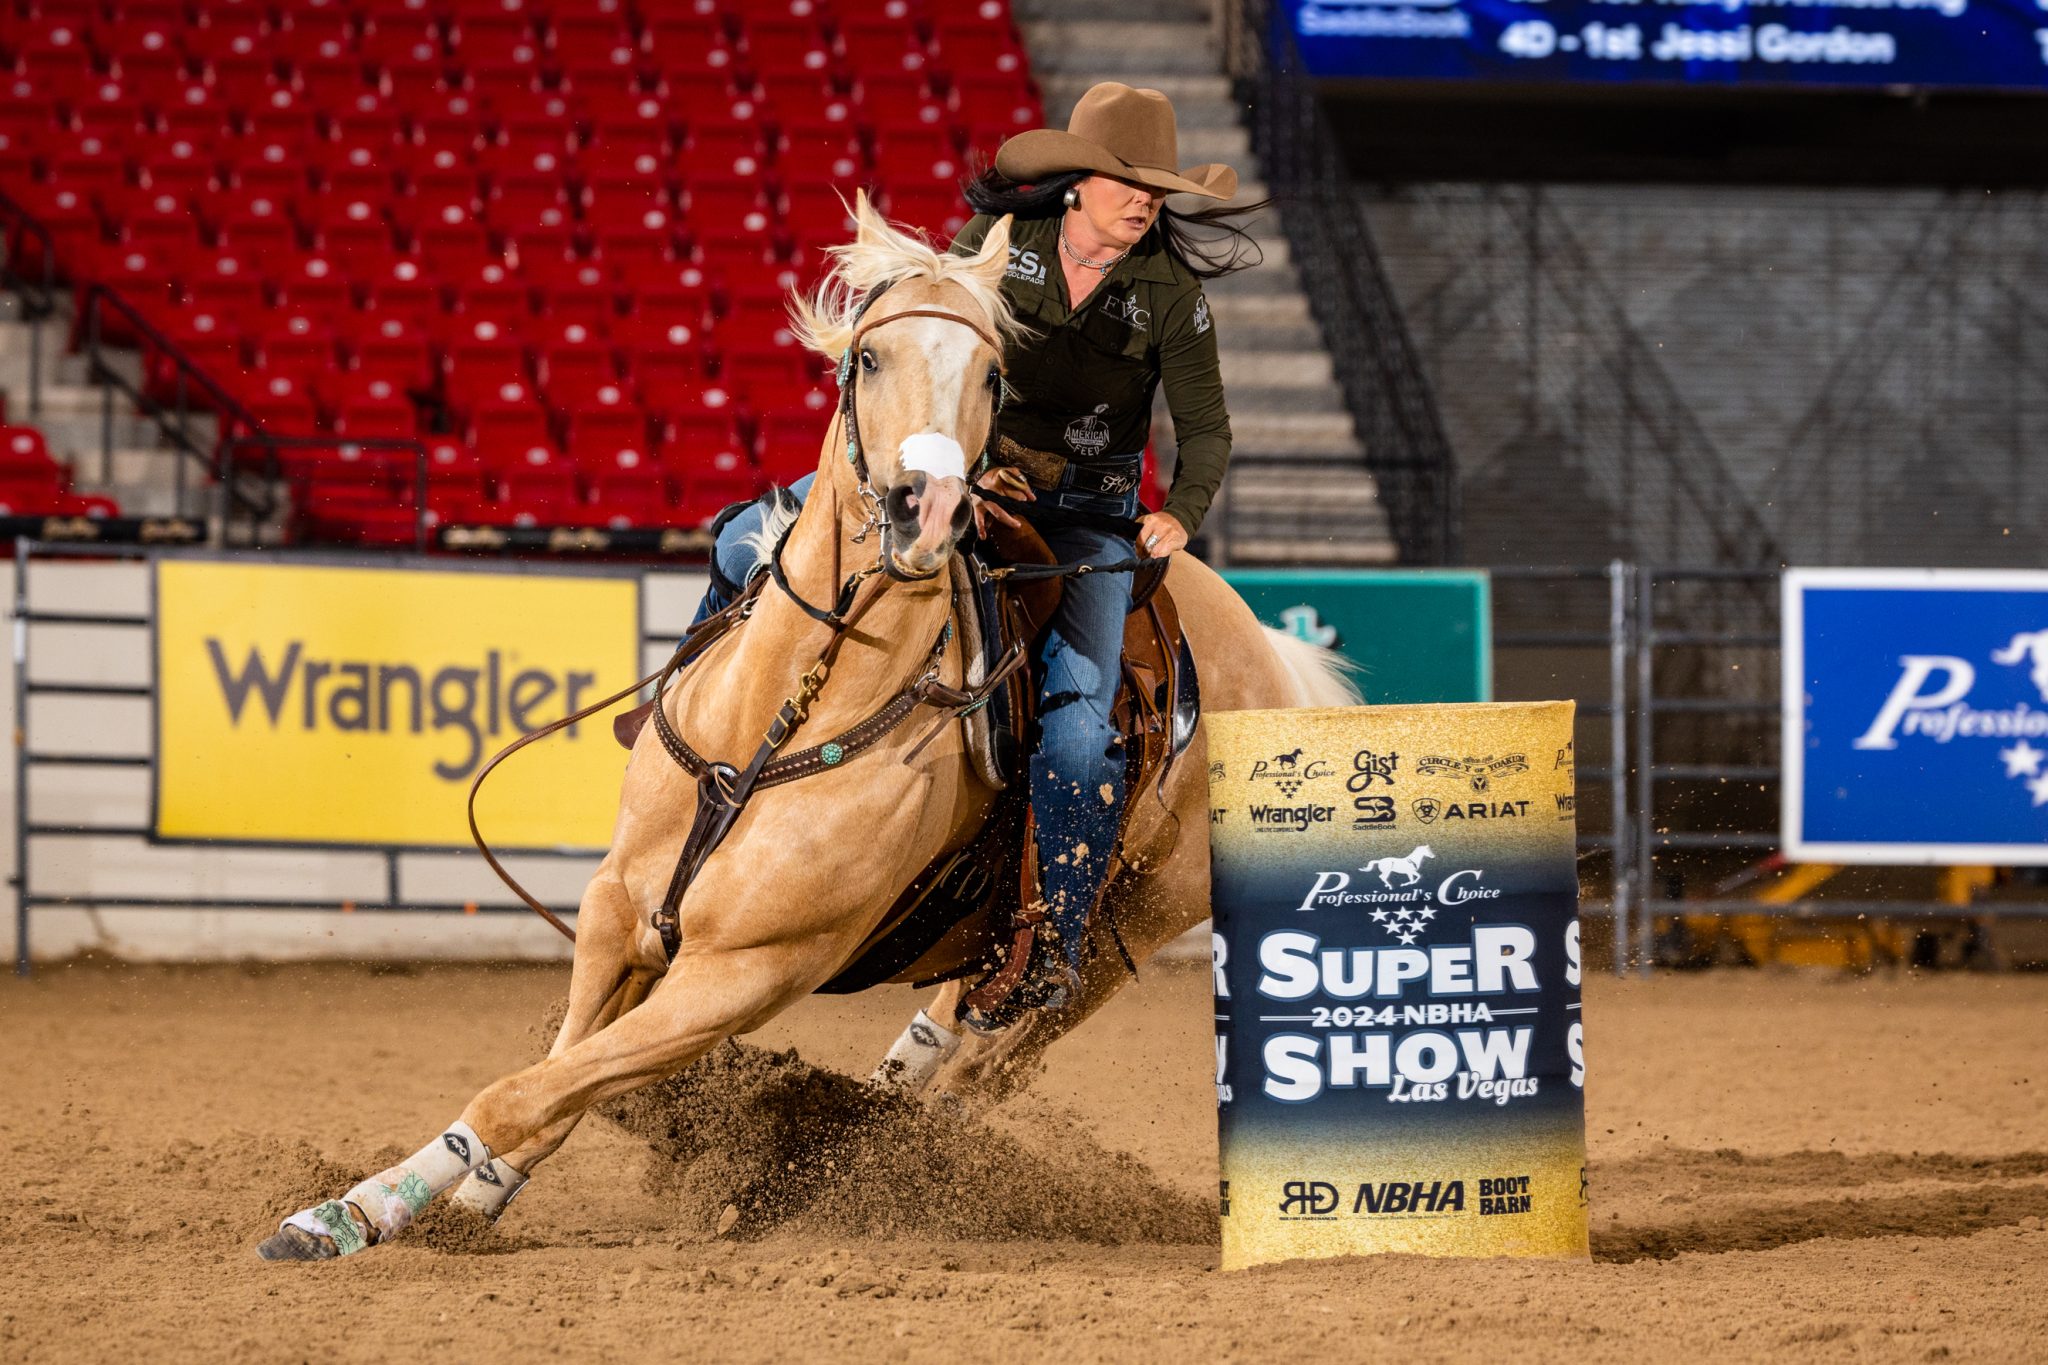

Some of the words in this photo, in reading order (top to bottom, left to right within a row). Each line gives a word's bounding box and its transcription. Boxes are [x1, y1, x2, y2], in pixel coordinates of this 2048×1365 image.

[1582, 21, 1643, 60] 1st
[1651, 22, 1752, 61] Jessi
[1755, 23, 1896, 63] Gordon
[1063, 425, 1110, 443] AMERICAN
[1073, 444, 1101, 456] FEED
[204, 636, 596, 782] Wrangler
[1853, 654, 2048, 750] Professio
[1249, 761, 1300, 782] Professional's
[1304, 761, 1336, 780] Choice
[1346, 750, 1400, 793] Gist
[1419, 757, 1461, 770] CIRCLE
[1464, 765, 1472, 773] Y
[1488, 755, 1526, 771] YOAKUM
[1250, 804, 1336, 832] Wrangler
[1444, 801, 1529, 819] ARIAT
[1352, 823, 1397, 831] SaddleBook
[1296, 871, 1432, 911] Professional's
[1437, 869, 1501, 906] Choice
[1257, 925, 1540, 999] SUPER
[1311, 1005, 1398, 1028] 2024
[1404, 1002, 1494, 1025] NBHA
[1262, 1027, 1533, 1102] SHOW
[1388, 1073, 1449, 1103] Las
[1456, 1070, 1539, 1106] Vegas
[1352, 1180, 1465, 1214] NBHA
[1479, 1176, 1529, 1196] BOOT
[1479, 1195, 1531, 1215] BARN
